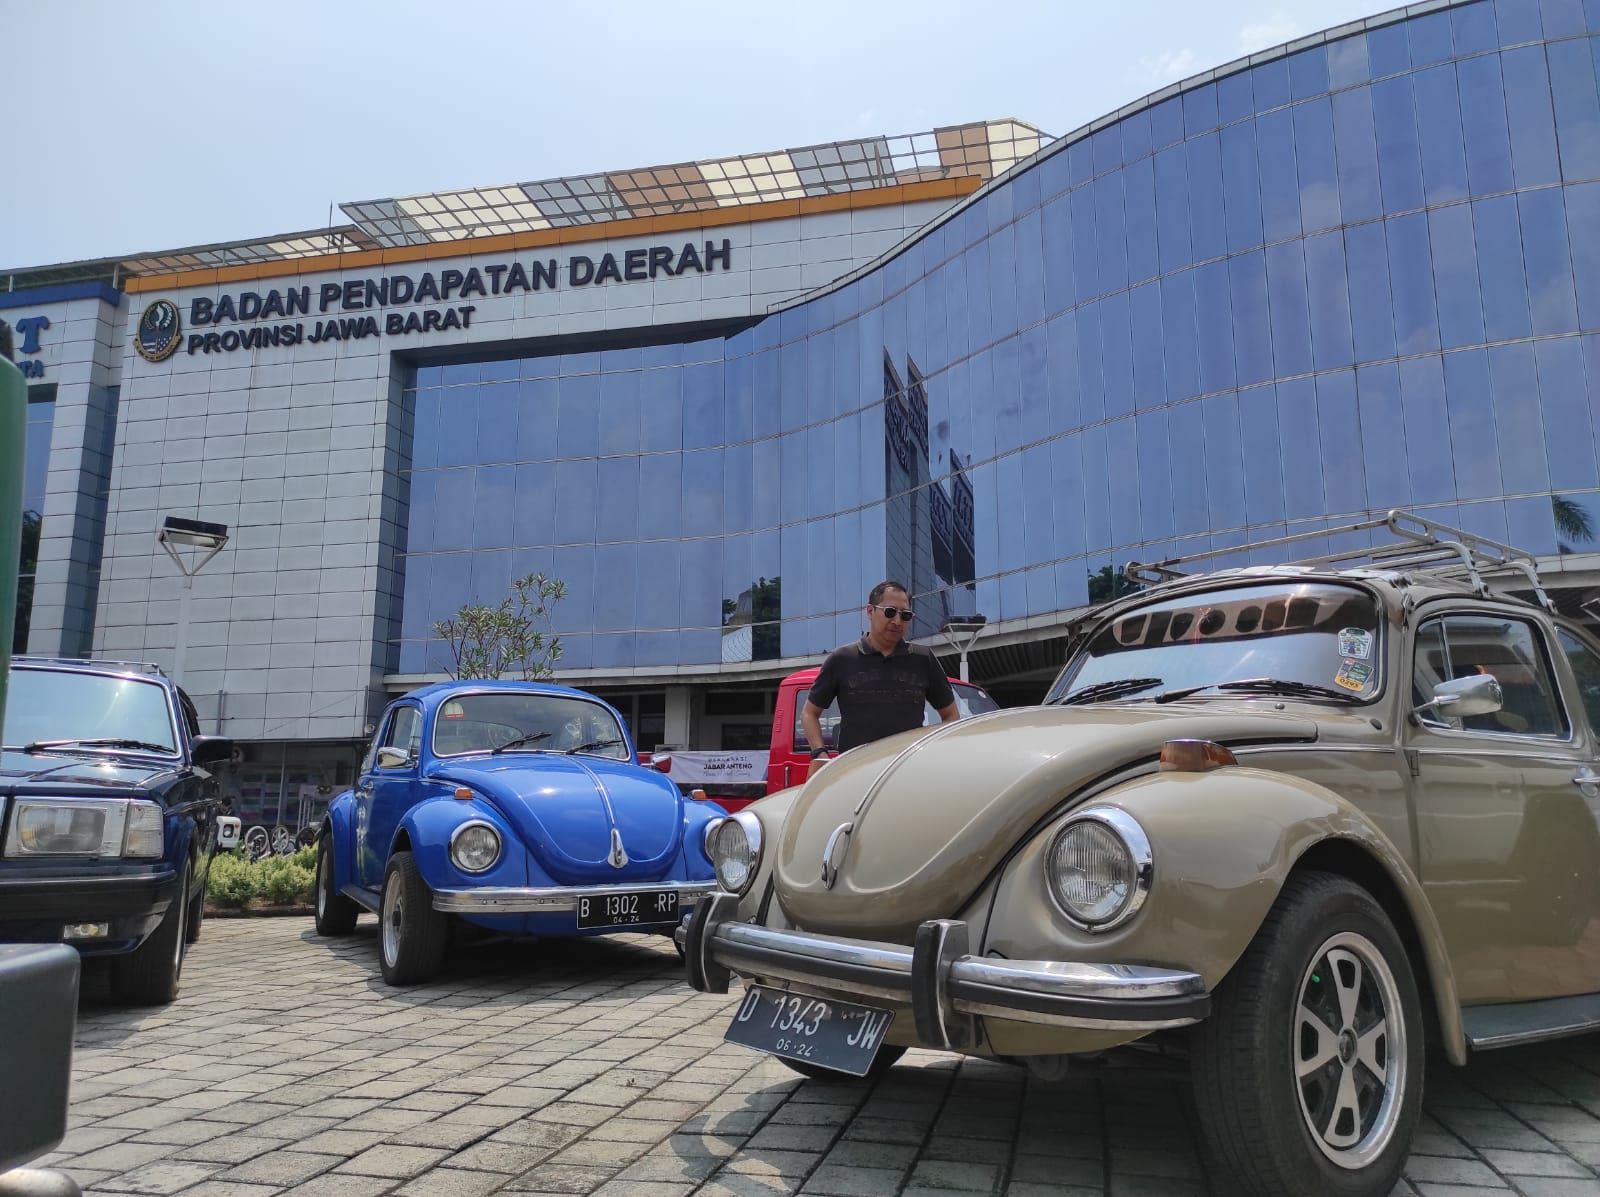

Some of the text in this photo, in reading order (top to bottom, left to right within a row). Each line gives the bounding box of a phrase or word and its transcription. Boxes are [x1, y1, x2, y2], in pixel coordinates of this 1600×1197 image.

[190, 239, 731, 326] BADAN PENDAPATAN DAERAH
[187, 323, 304, 355] PROVINSI
[308, 312, 379, 344] JAWA
[385, 305, 476, 336] BARAT
[580, 893, 677, 918] B 1302 RP
[738, 989, 888, 1050] D 1343 JW
